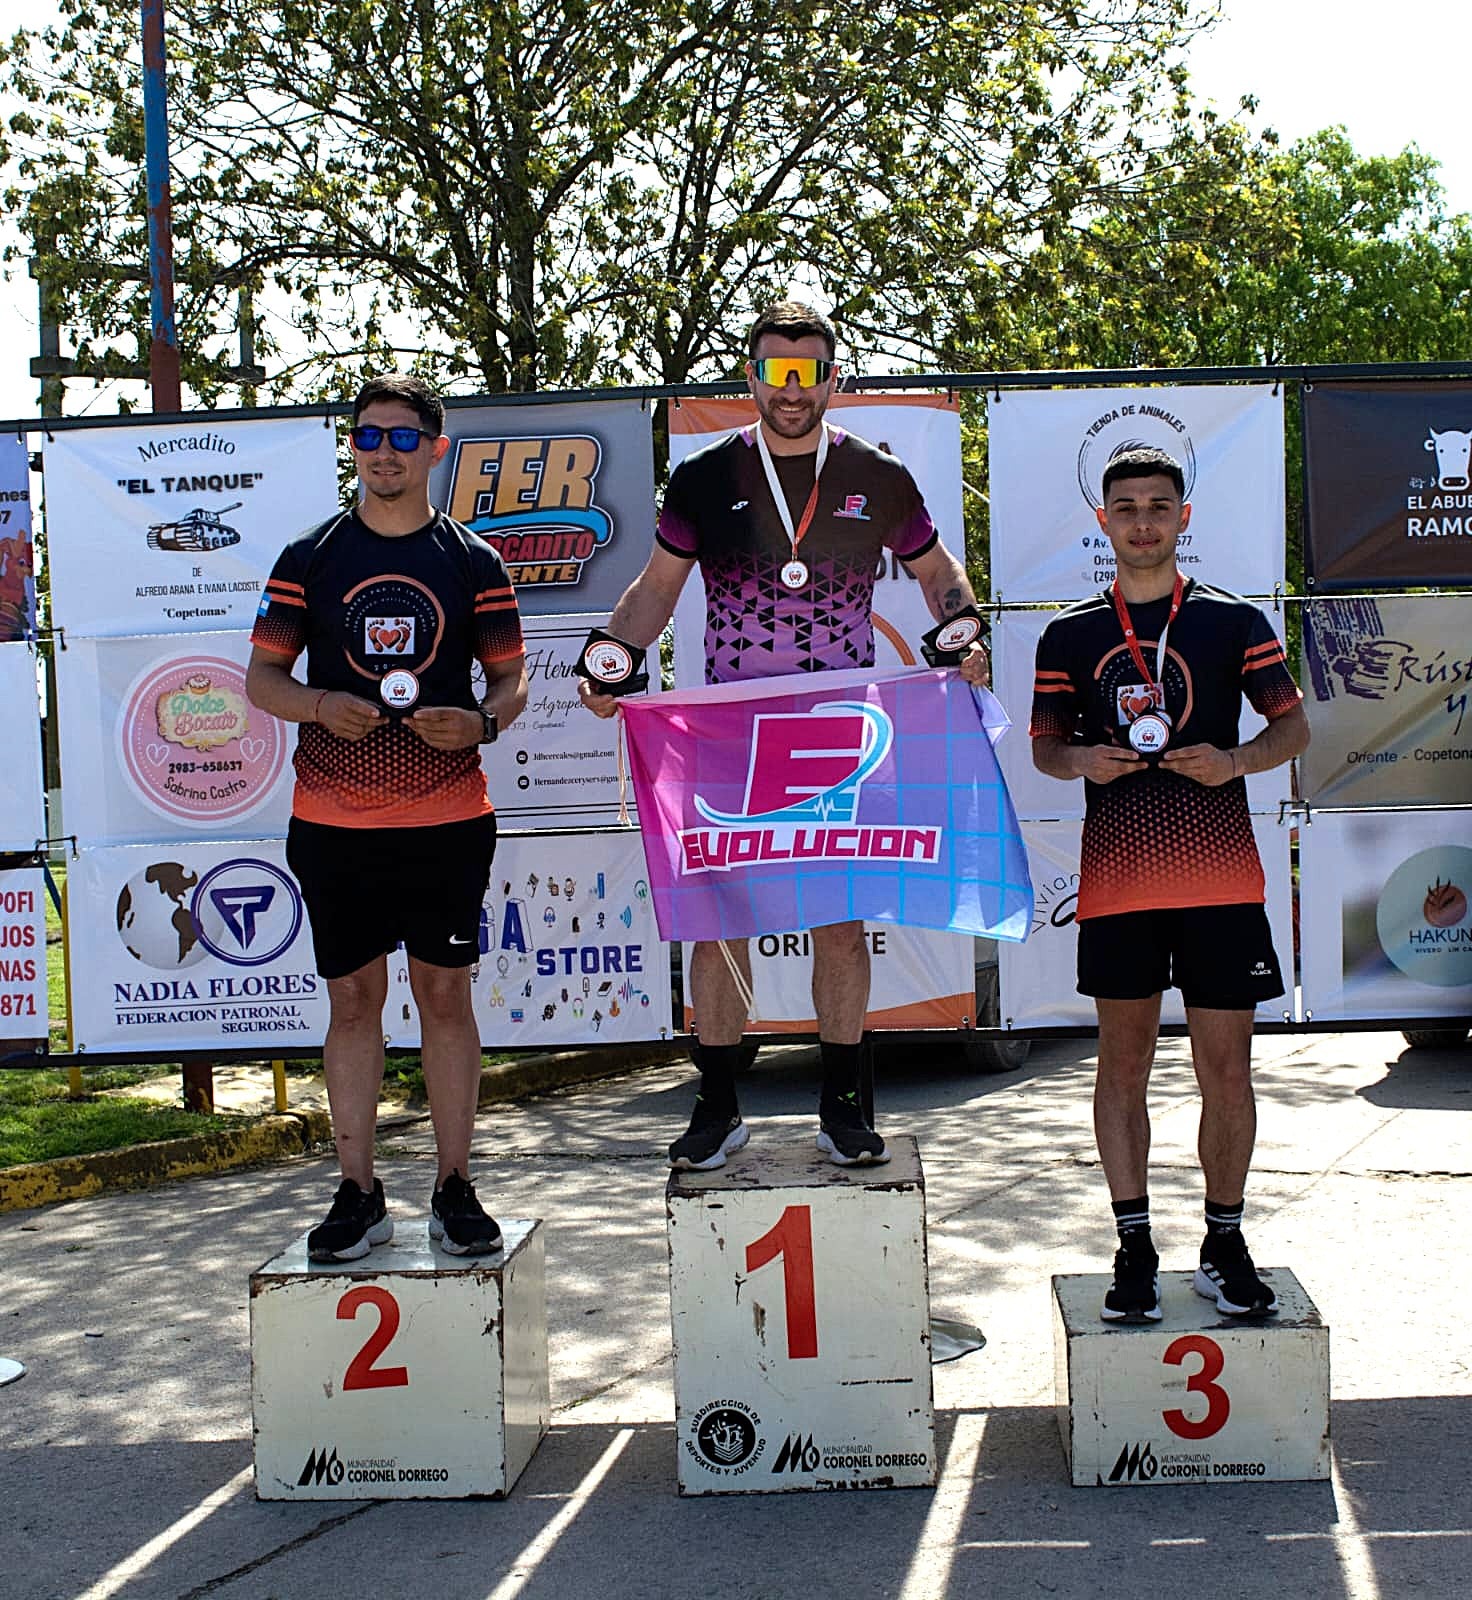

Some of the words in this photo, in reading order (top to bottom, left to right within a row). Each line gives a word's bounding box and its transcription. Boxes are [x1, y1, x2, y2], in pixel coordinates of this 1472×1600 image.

[1086, 410, 1120, 437] TIENDA
[1121, 405, 1136, 416] DE
[1138, 405, 1186, 433] ANIMALES
[137, 432, 236, 462] Mercadito
[117, 478, 156, 494] "EL
[161, 472, 264, 492] TANQUE"
[451, 438, 598, 524] FER
[1407, 495, 1427, 510] EL
[1093, 538, 1109, 549] Av.
[1093, 555, 1118, 566] Orie
[192, 567, 202, 577] DE
[507, 564, 578, 583] ENTE
[1093, 571, 1116, 584] (298
[135, 585, 168, 597] ALFREDO
[169, 583, 195, 595] ARANA
[197, 584, 203, 594] E
[204, 582, 227, 594] IVANA
[228, 581, 261, 593] LACOSTE
[1347, 751, 1398, 764] Oriente
[164, 776, 207, 800] Sabrina
[209, 779, 247, 800] Castro
[681, 828, 938, 873] EVOLUCION
[758, 931, 886, 957] ORIE
[536, 944, 643, 976] STORE
[113, 980, 200, 1003] NADIA
[208, 973, 317, 998] FLORES
[116, 1008, 217, 1025] FEDERACION
[221, 1005, 301, 1020] PATRONAL
[221, 1020, 286, 1034] SEGUROS
[287, 1019, 310, 1031] S.A.
[745, 1204, 818, 1359] 1
[336, 1285, 409, 1391] 2
[1162, 1334, 1231, 1440] 3
[691, 1399, 751, 1433] SUBDIRECCION
[749, 1412, 762, 1426] DE
[685, 1440, 722, 1475] DEPORTES
[732, 1438, 767, 1476] JUVENTUD
[823, 1455, 873, 1469] CORONEL
[875, 1453, 927, 1467] DORREGO
[347, 1469, 396, 1483] CORONEL
[398, 1468, 449, 1482] DORREGO
[1213, 1463, 1266, 1477] DORREGO
